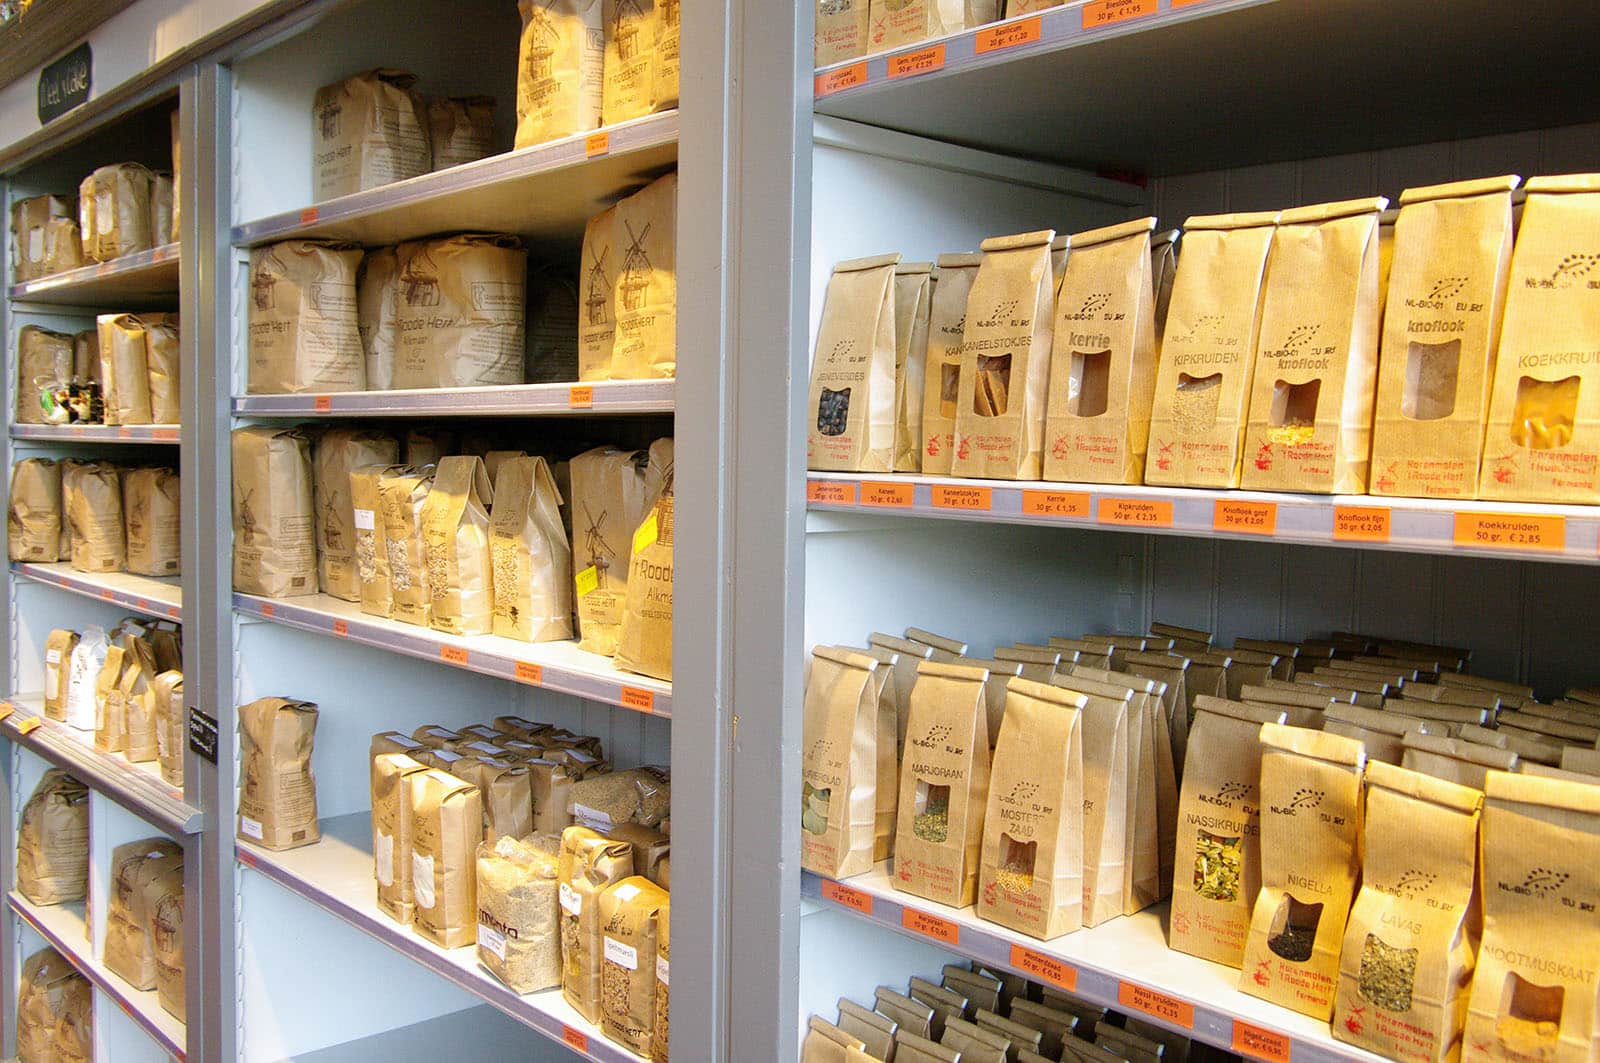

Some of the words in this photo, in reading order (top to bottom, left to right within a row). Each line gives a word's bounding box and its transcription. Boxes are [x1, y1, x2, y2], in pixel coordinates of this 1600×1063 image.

[1407, 320, 1464, 332] knoflook
[963, 335, 1032, 351] KANEELSTOKJES
[1069, 332, 1111, 348] kerrie
[1174, 352, 1238, 366] KIPKRUIDEN
[1278, 358, 1329, 370] knoflook
[1119, 502, 1154, 511] Kipkruiden
[1223, 507, 1252, 516] Knoflook
[1253, 509, 1268, 517] grof
[1338, 514, 1370, 522] Knoflook
[1372, 515, 1384, 523] fijn
[1478, 521, 1539, 531] Koekkruiden
[1476, 531, 1488, 540] 50
[1491, 533, 1502, 542] gr.
[1519, 534, 1541, 544] 2,85
[912, 763, 963, 779] MARJORAAN
[1009, 823, 1034, 837] ZAAD
[1288, 874, 1333, 896] NIGELLA
[1380, 912, 1422, 935] LAVAS
